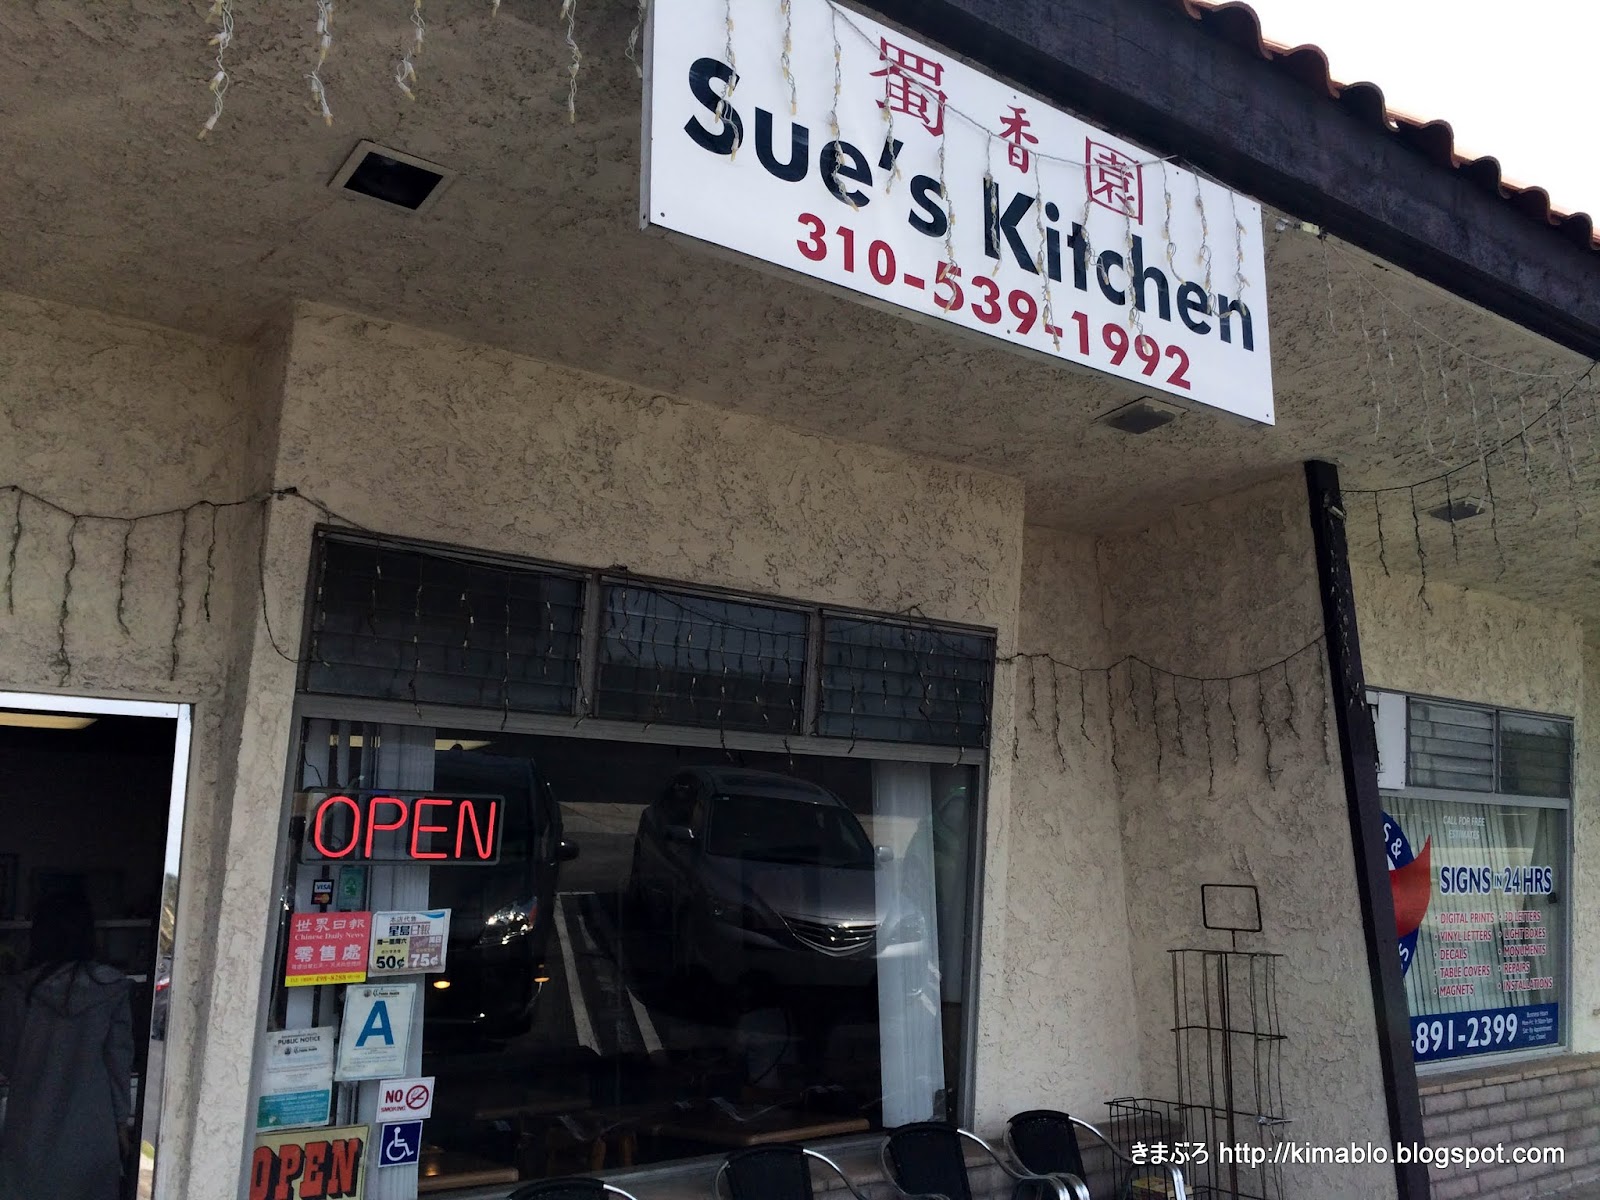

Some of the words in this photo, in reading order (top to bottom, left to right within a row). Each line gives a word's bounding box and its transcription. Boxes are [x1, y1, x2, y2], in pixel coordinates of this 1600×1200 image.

[869, 36, 1144, 225] 蜀香園
[682, 56, 949, 240] Sue's
[982, 174, 1255, 353] Kitchen
[795, 212, 1192, 391] 310-539-1992
[314, 795, 497, 860] OPEN
[1440, 866, 1491, 895] SIGNS
[1494, 874, 1503, 888] IN
[1504, 866, 1520, 894] 24
[1523, 866, 1552, 894] HRS
[1440, 913, 1468, 924] DIGITAL
[1470, 912, 1495, 923] PRINTS
[1515, 911, 1541, 922] LETTERS
[325, 932, 343, 940] Daily
[1440, 931, 1462, 942] VINYL
[1463, 930, 1492, 941] LETTERS
[1504, 928, 1524, 939] LIGHT
[1525, 927, 1546, 939] BOXES
[1440, 949, 1468, 960] DECALS
[1503, 944, 1546, 957] MONUMENTS
[1440, 966, 1462, 978] TABLE
[1463, 965, 1491, 977] COVERS
[1503, 962, 1531, 974] REPAIRS
[1439, 984, 1475, 996] MAGNETS
[1503, 977, 1552, 992] INSTALLATIONS
[355, 1000, 395, 1047] A
[277, 1037, 299, 1045] PUBLIC
[385, 1089, 403, 1104] NO
[381, 1105, 406, 1113] SMOKING
[248, 1137, 365, 1200] OPEN
